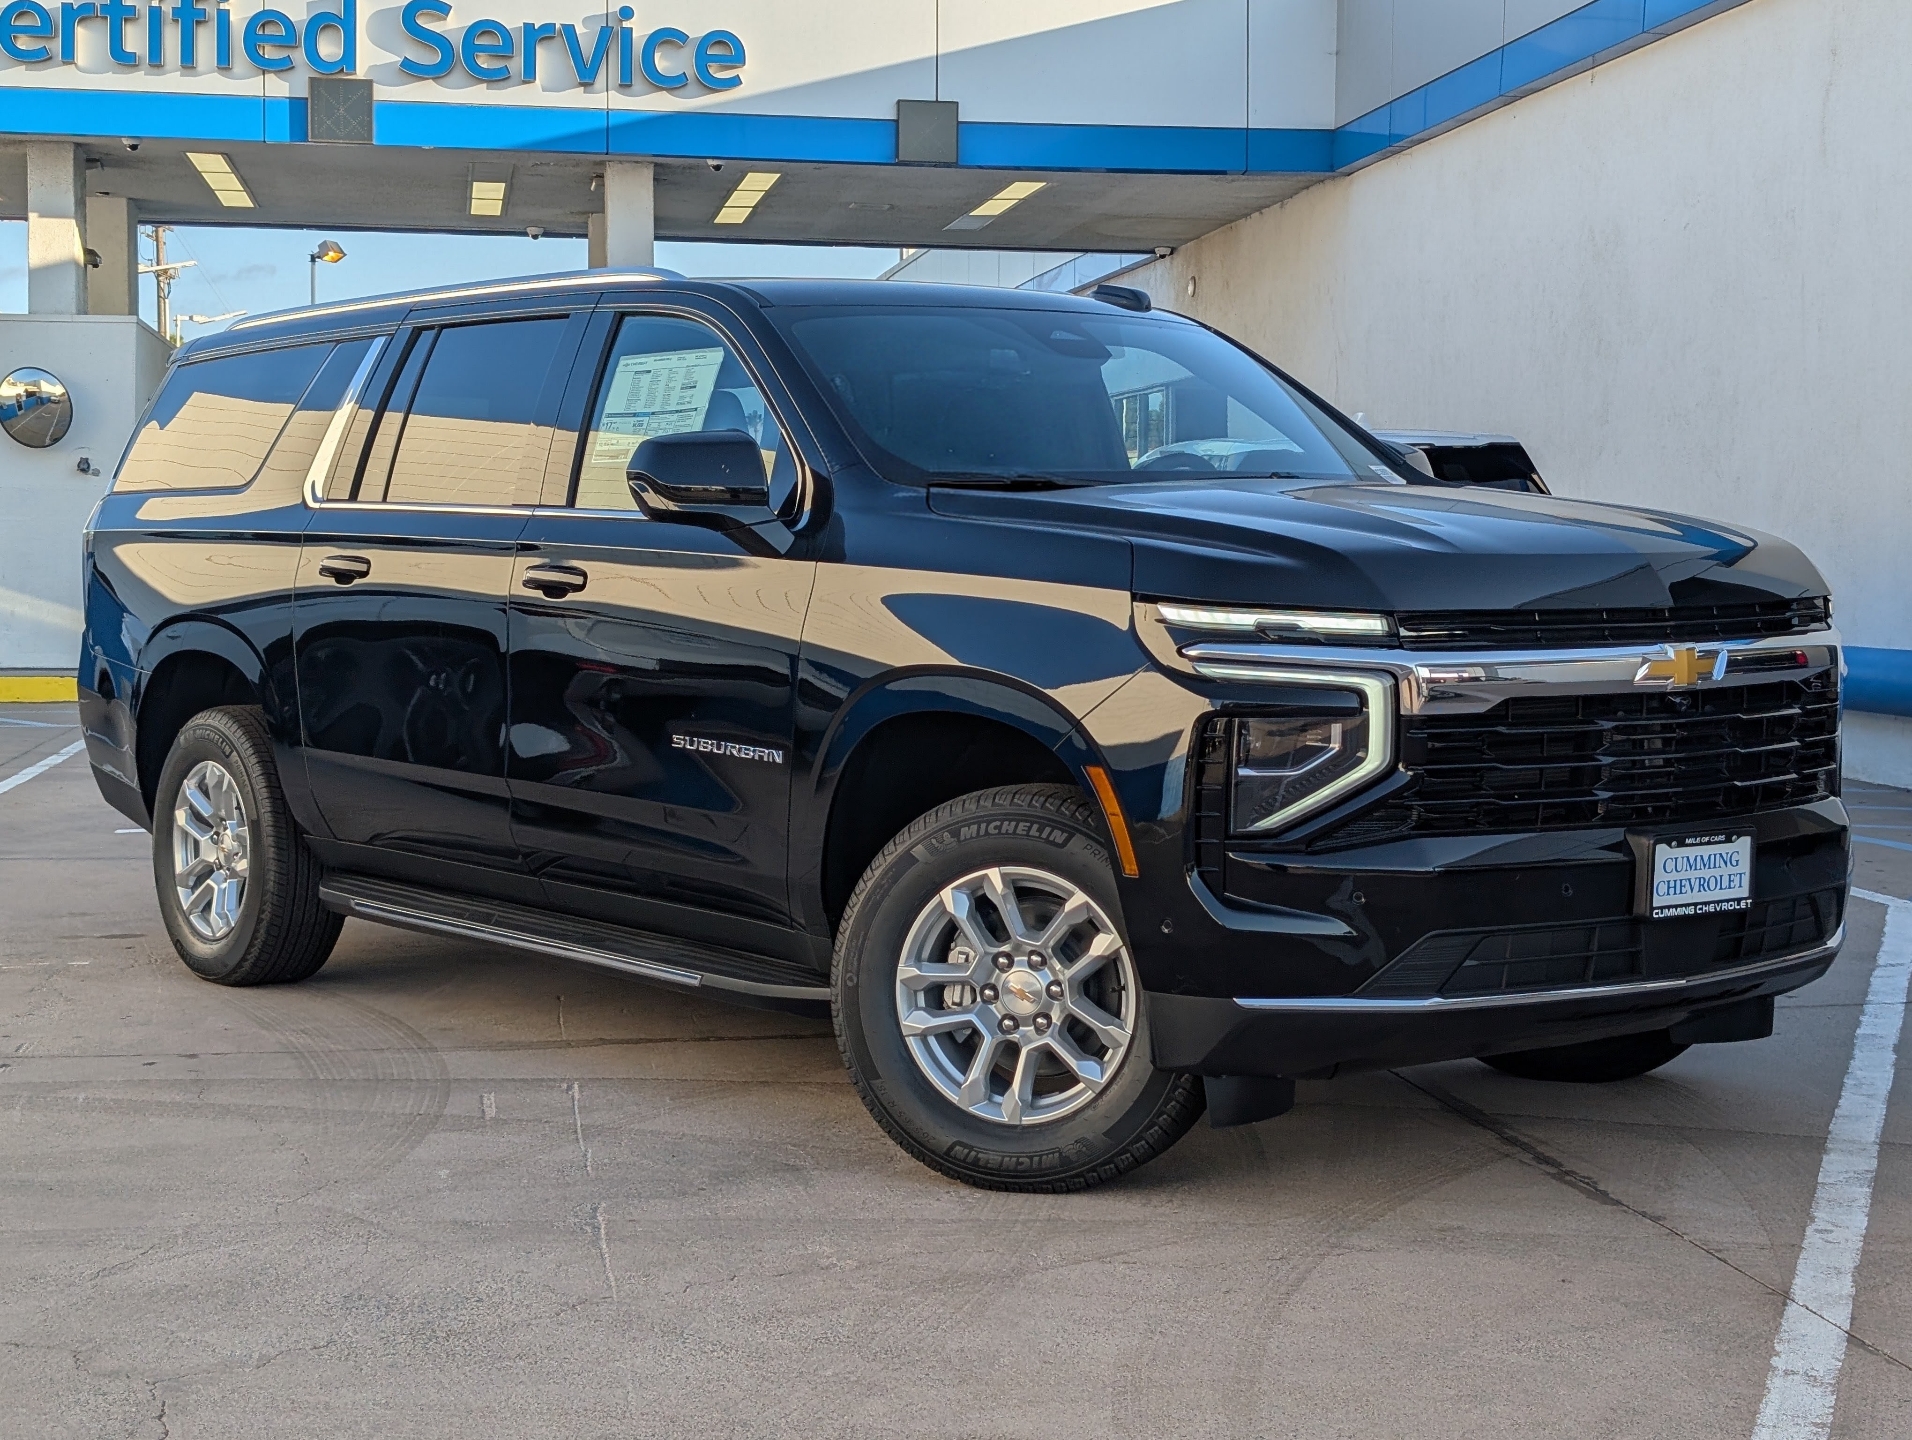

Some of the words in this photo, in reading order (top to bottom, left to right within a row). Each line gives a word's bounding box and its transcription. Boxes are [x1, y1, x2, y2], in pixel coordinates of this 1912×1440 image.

[0, 0, 357, 75] ertified
[398, 0, 747, 90] Service
[194, 728, 232, 756] MICHELIN
[671, 734, 783, 764] SUBURBAN
[959, 820, 1069, 845] MICHELIN
[1710, 834, 1726, 842] CARS
[1082, 843, 1112, 869] PRIM
[1662, 850, 1740, 874] CUMMING
[1655, 871, 1746, 897] CHEVROLET
[1652, 905, 1695, 918] CUMMING
[1696, 899, 1753, 914] CHEVROLET
[949, 1145, 1061, 1171] MICHELIN
